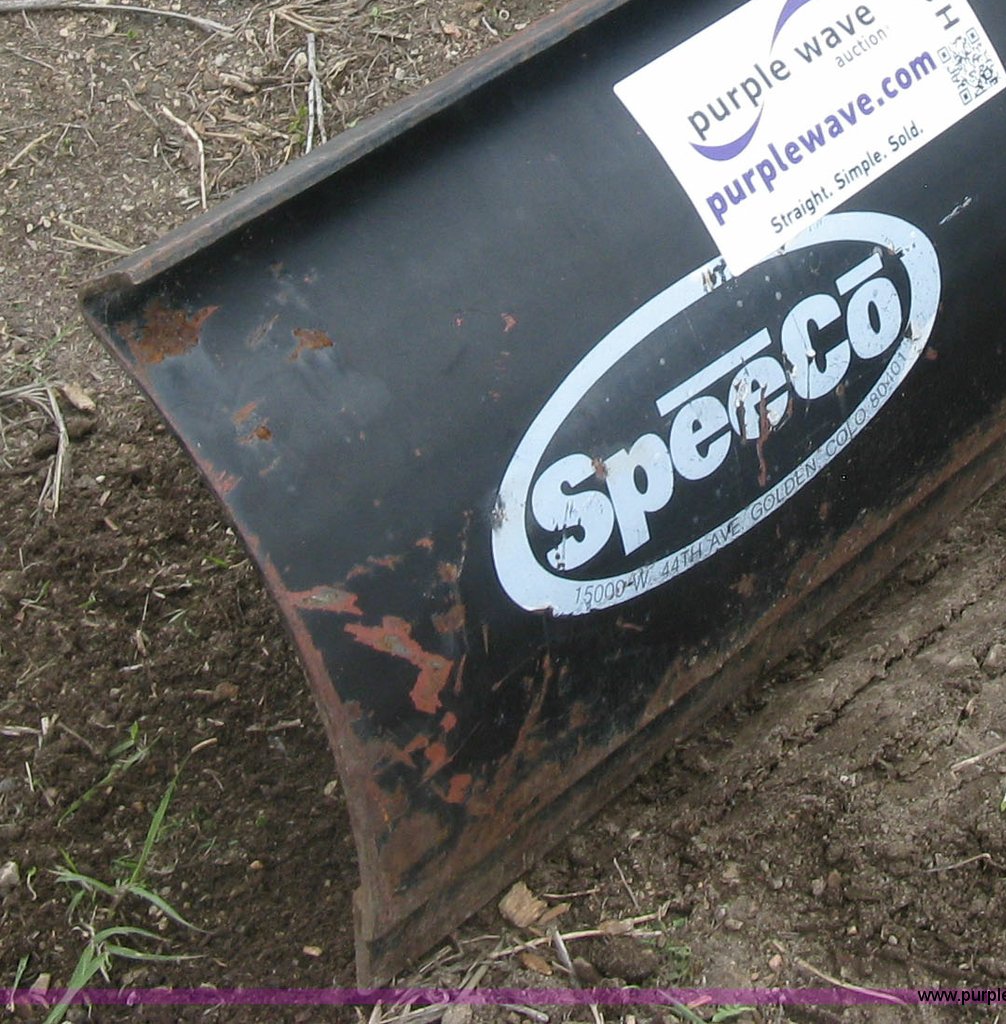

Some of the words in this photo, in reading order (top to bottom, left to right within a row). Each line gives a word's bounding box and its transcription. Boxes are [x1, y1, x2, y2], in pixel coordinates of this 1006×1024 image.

[835, 28, 888, 68] auction
[935, 4, 960, 31] H
[687, 55, 791, 140] purple
[794, 2, 877, 64] wave
[706, 50, 938, 226] purplewave.com
[770, 185, 833, 234] Straight.
[834, 151, 888, 190] Simple.
[888, 119, 924, 152] Sold.
[661, 543, 702, 577] 44TH
